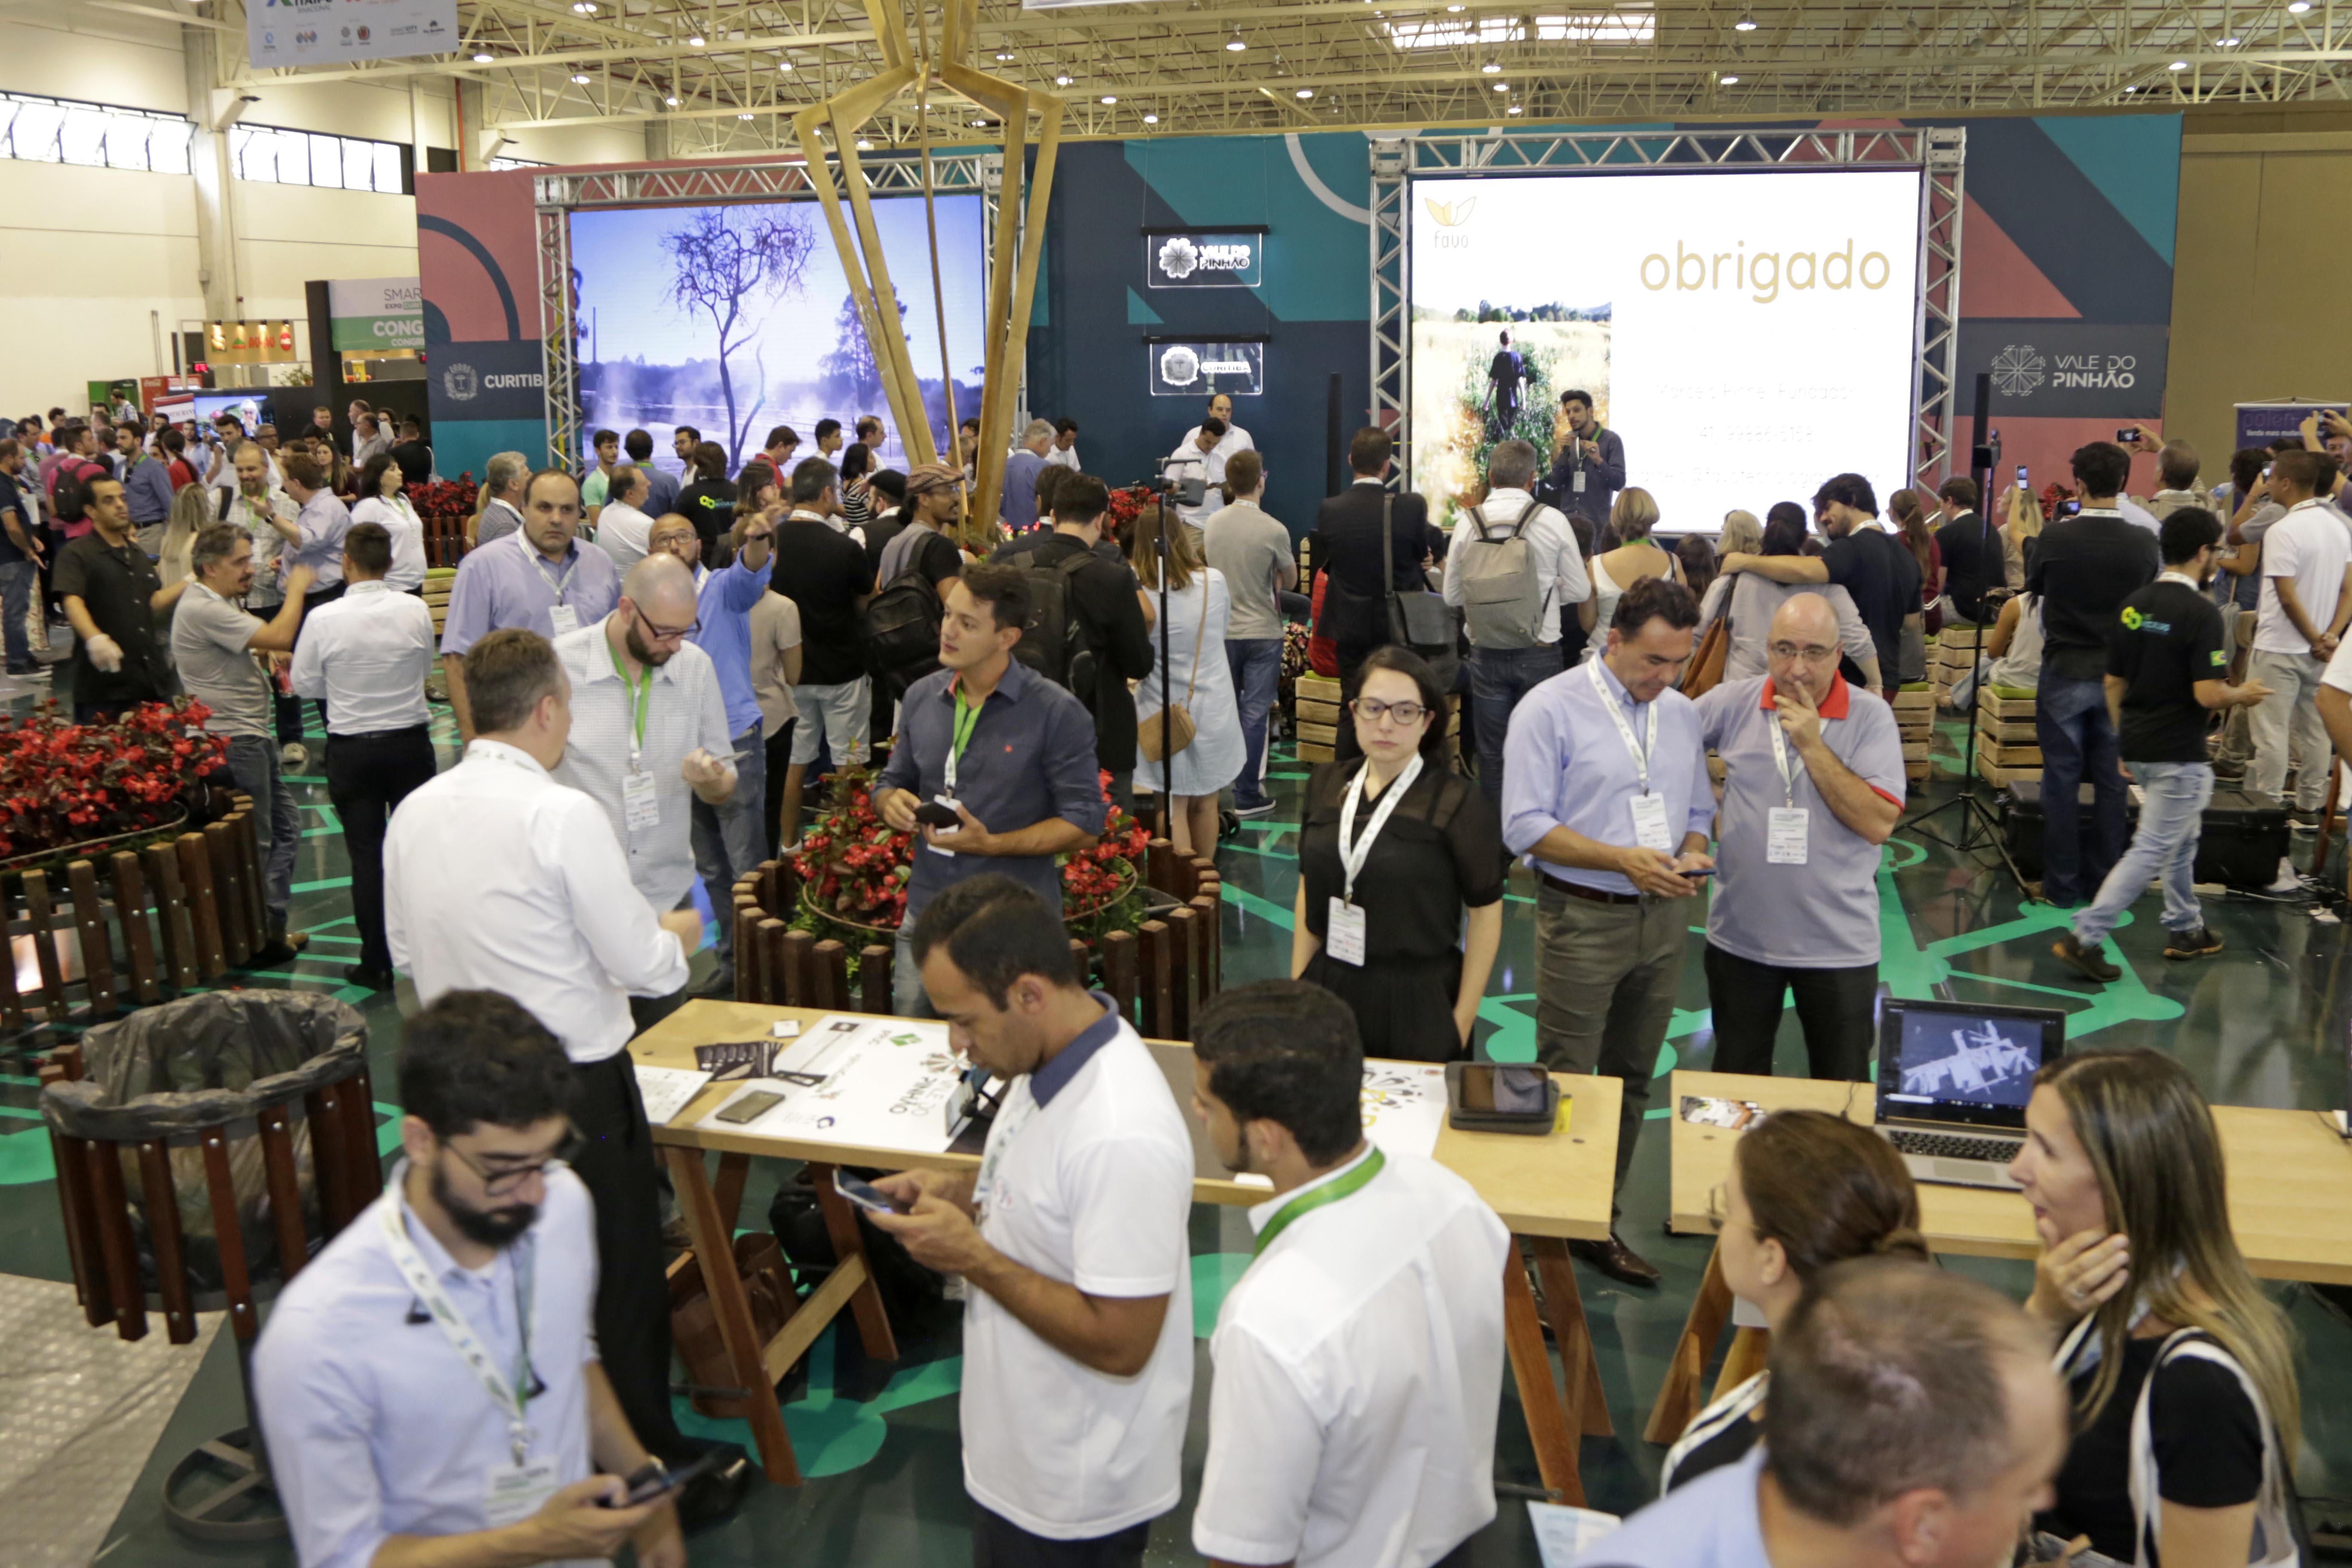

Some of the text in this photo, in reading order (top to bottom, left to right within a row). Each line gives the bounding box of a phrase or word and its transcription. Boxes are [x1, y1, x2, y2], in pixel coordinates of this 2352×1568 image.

[1640, 238, 1890, 303] obrigado
[373, 320, 424, 337] CONG
[2055, 355, 2136, 370] VALE DO
[2053, 371, 2135, 388] PINHÃO
